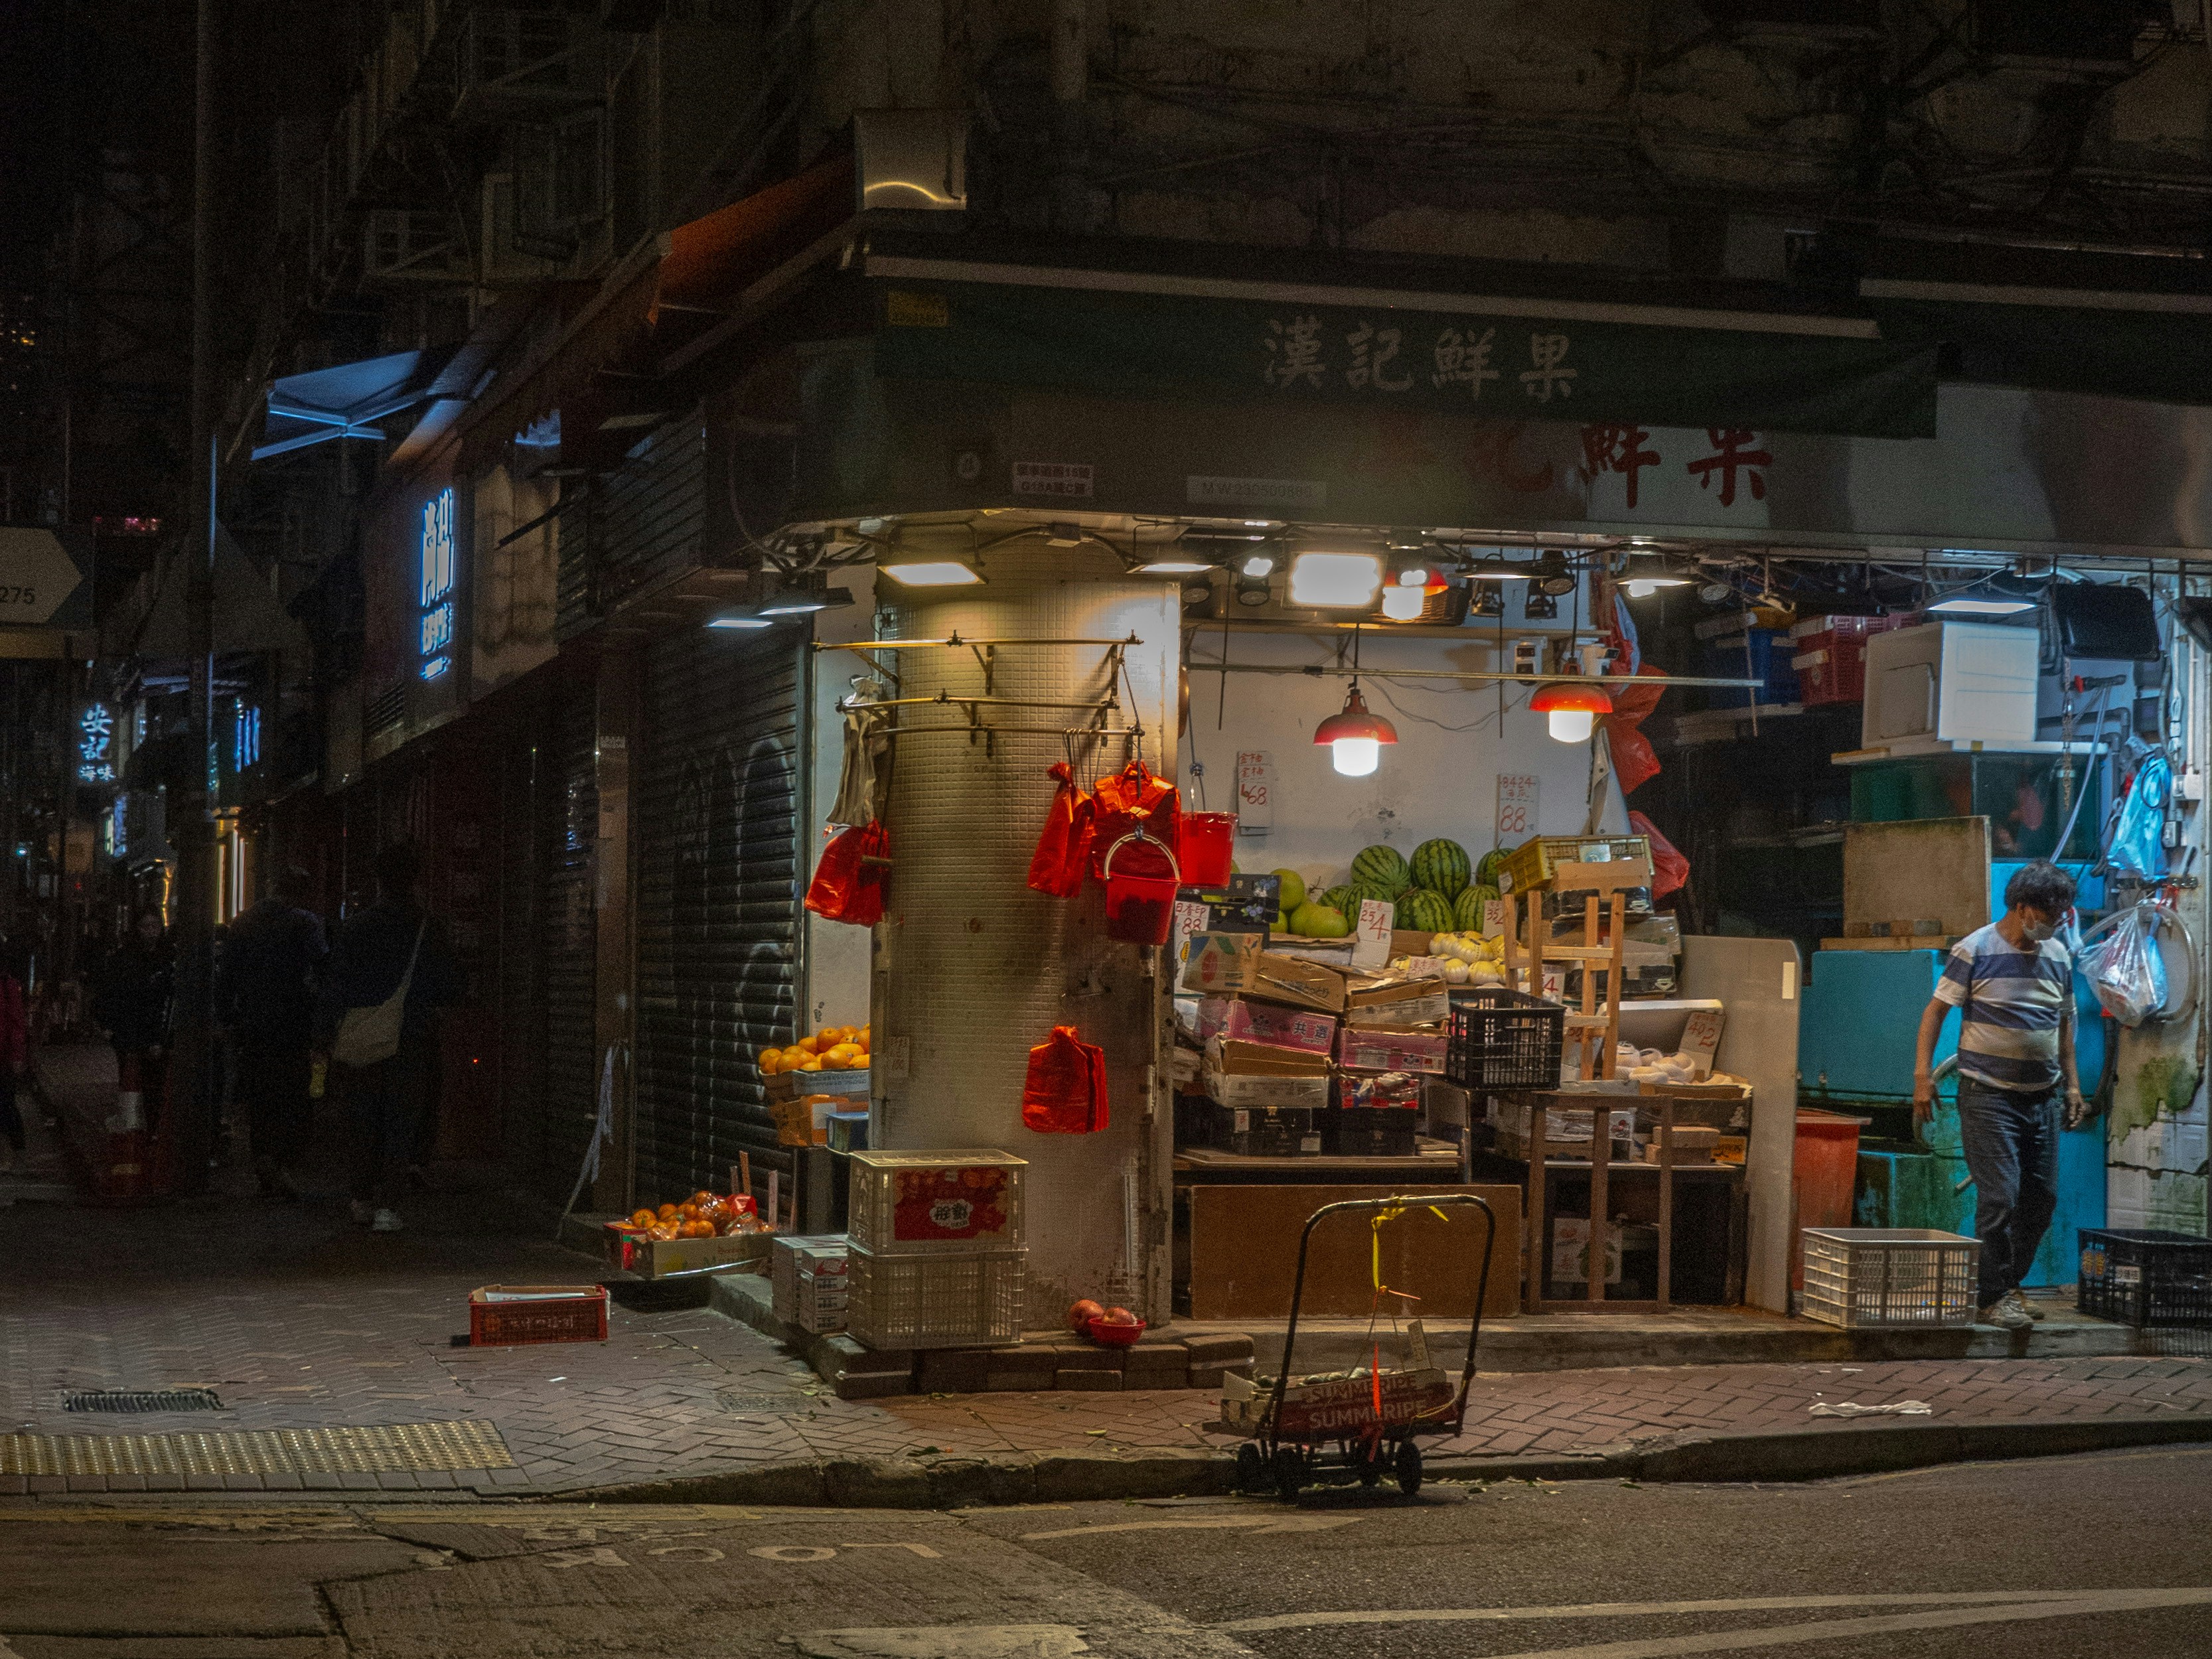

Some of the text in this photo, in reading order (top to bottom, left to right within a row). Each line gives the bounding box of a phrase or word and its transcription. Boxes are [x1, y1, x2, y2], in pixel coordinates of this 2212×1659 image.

[1263, 315, 1578, 402] 漢記鮮果
[1499, 804, 1527, 833] 88
